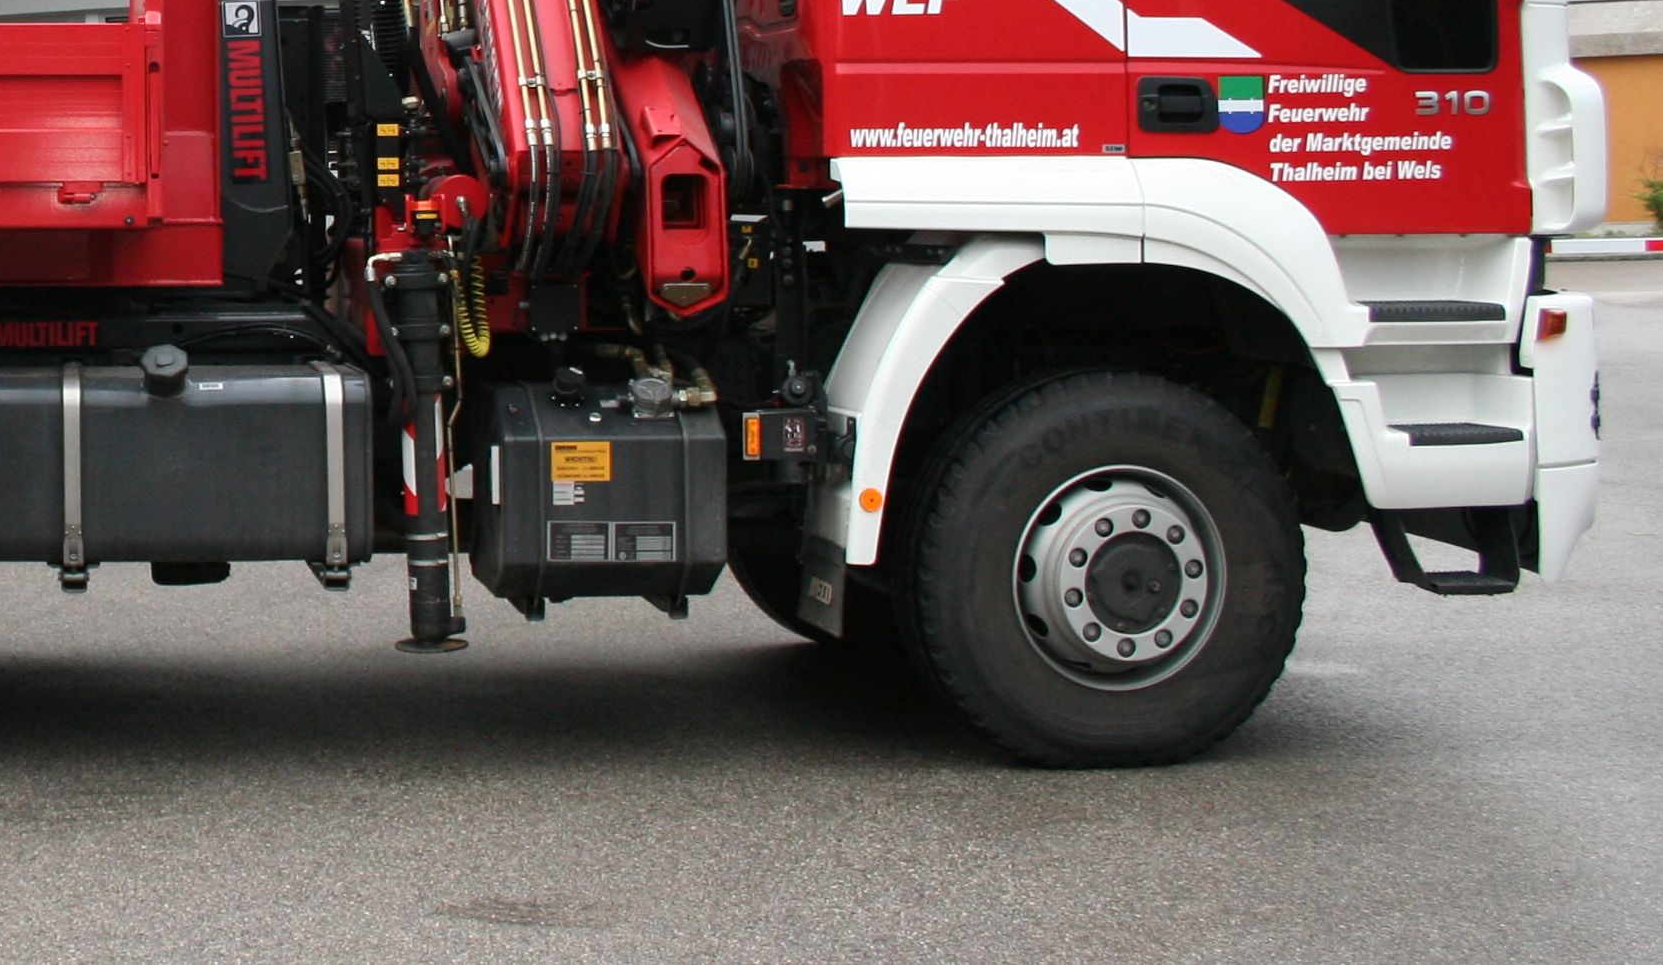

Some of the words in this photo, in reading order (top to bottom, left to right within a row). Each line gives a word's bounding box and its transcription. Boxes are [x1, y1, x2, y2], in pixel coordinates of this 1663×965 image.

[1268, 74, 1367, 97] Freiwillige
[227, 39, 268, 180] MULTILIFT
[1267, 103, 1369, 123] Feuerwehr
[1415, 90, 1490, 116] 310
[850, 121, 1080, 148] www.feuerwehr-thalheim.at
[1269, 133, 1301, 152] der
[1305, 131, 1452, 155] Marktgemeinde
[1269, 162, 1358, 181] Thalheim
[1362, 161, 1393, 180] bei
[1397, 160, 1442, 180] Wels
